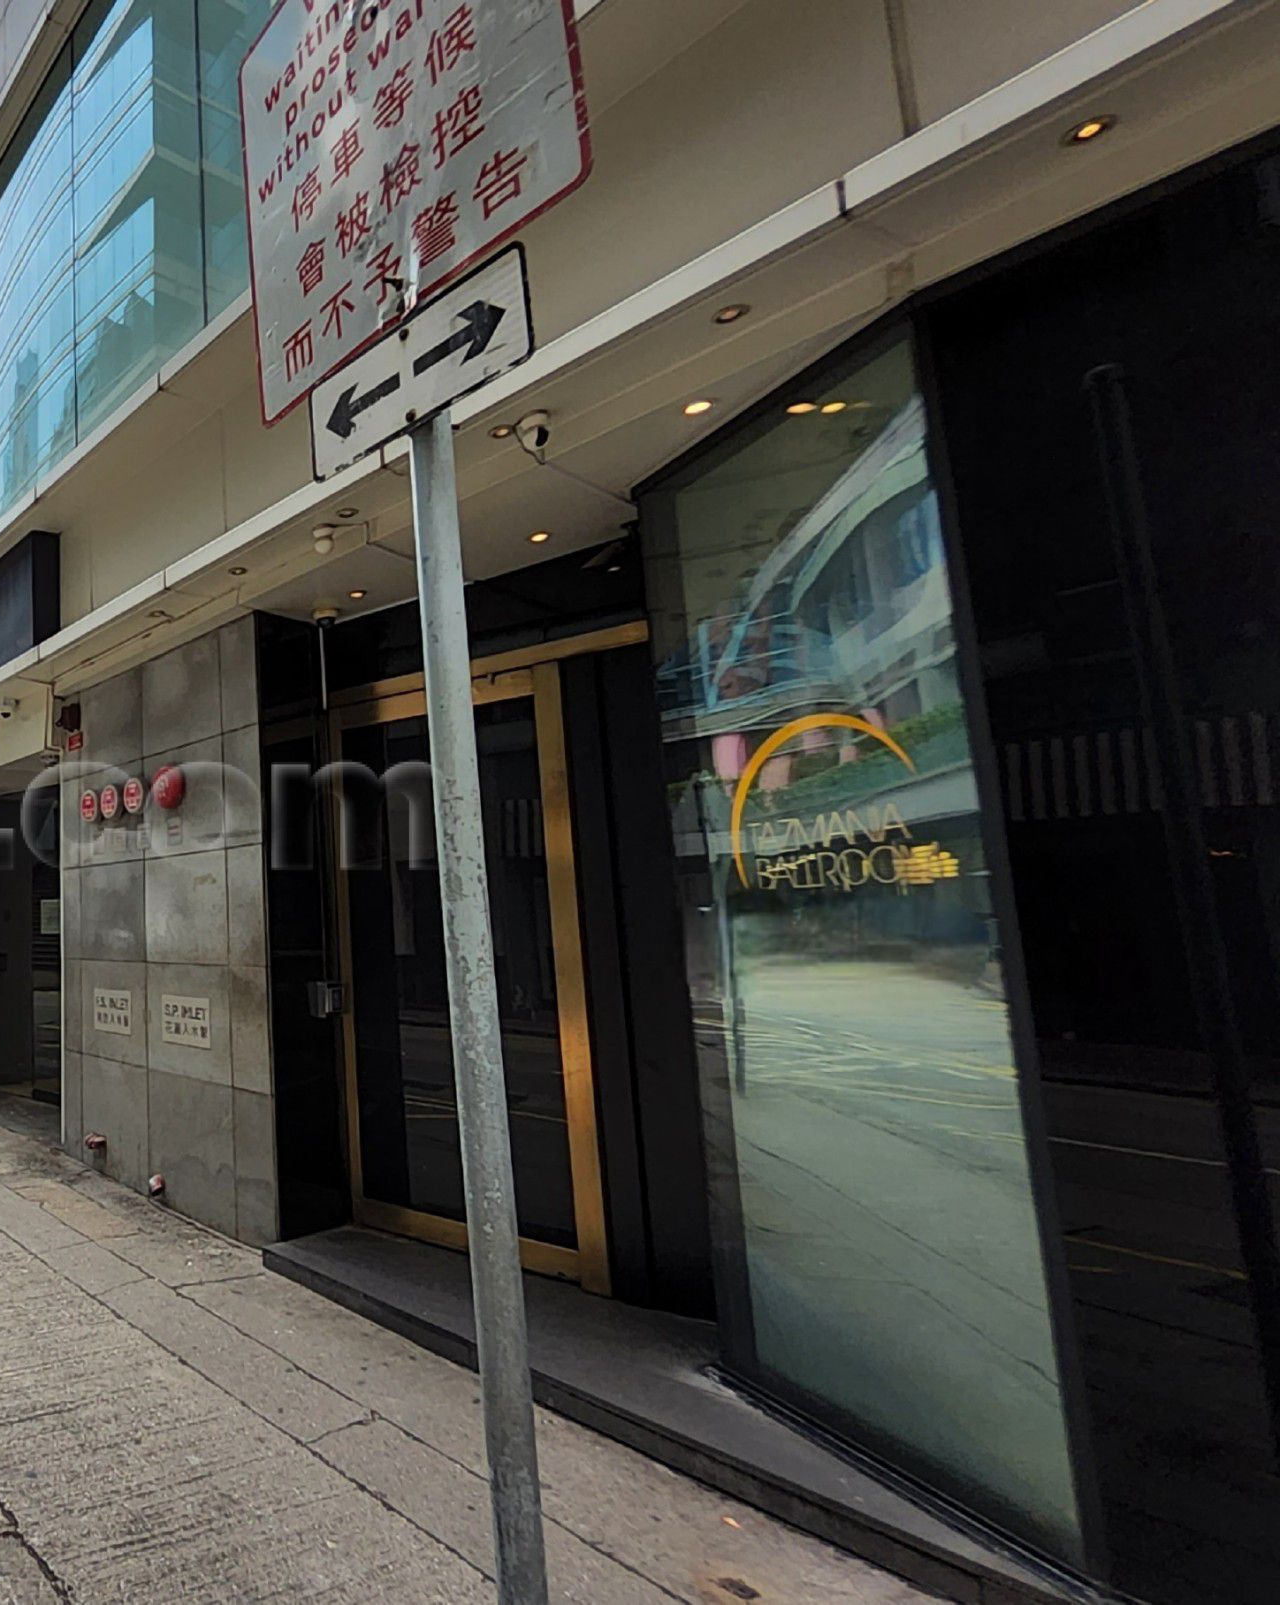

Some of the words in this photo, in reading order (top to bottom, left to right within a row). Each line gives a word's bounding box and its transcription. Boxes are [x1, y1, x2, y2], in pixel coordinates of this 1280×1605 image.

[264, 0, 352, 113] waitin
[290, 2, 478, 232] 停車等候
[258, 68, 357, 203] without
[296, 83, 486, 298] 會被檢控
[282, 146, 528, 382] 而不予警告
[754, 843, 924, 896] BALLROO
[181, 1005, 207, 1022] INLET
